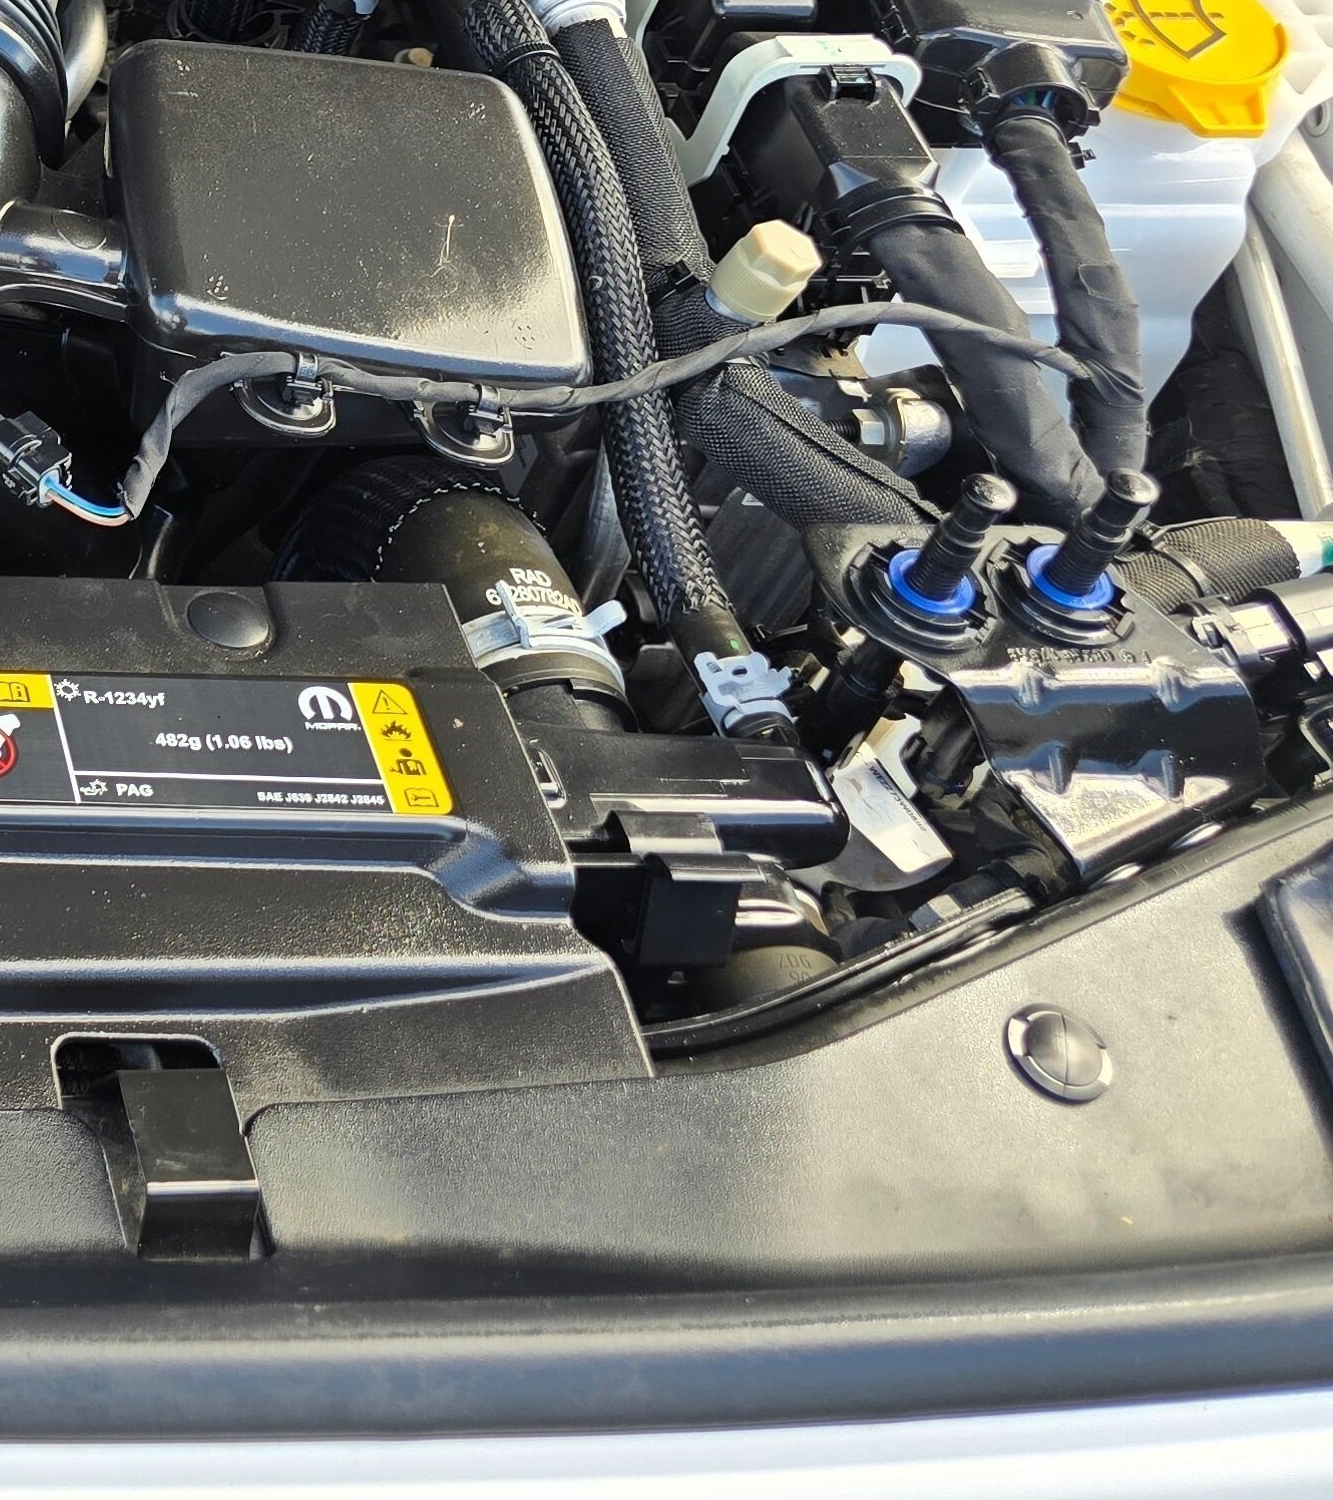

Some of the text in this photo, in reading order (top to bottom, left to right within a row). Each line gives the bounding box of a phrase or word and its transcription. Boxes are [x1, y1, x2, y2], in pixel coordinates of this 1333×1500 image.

[508, 567, 552, 588] RAD
[485, 585, 583, 617] 6280782AD
[83, 690, 165, 709] R-1234yf
[155, 732, 293, 754] 482g (1.06 lbs)
[115, 783, 154, 797] PAG
[256, 791, 284, 802] SAE
